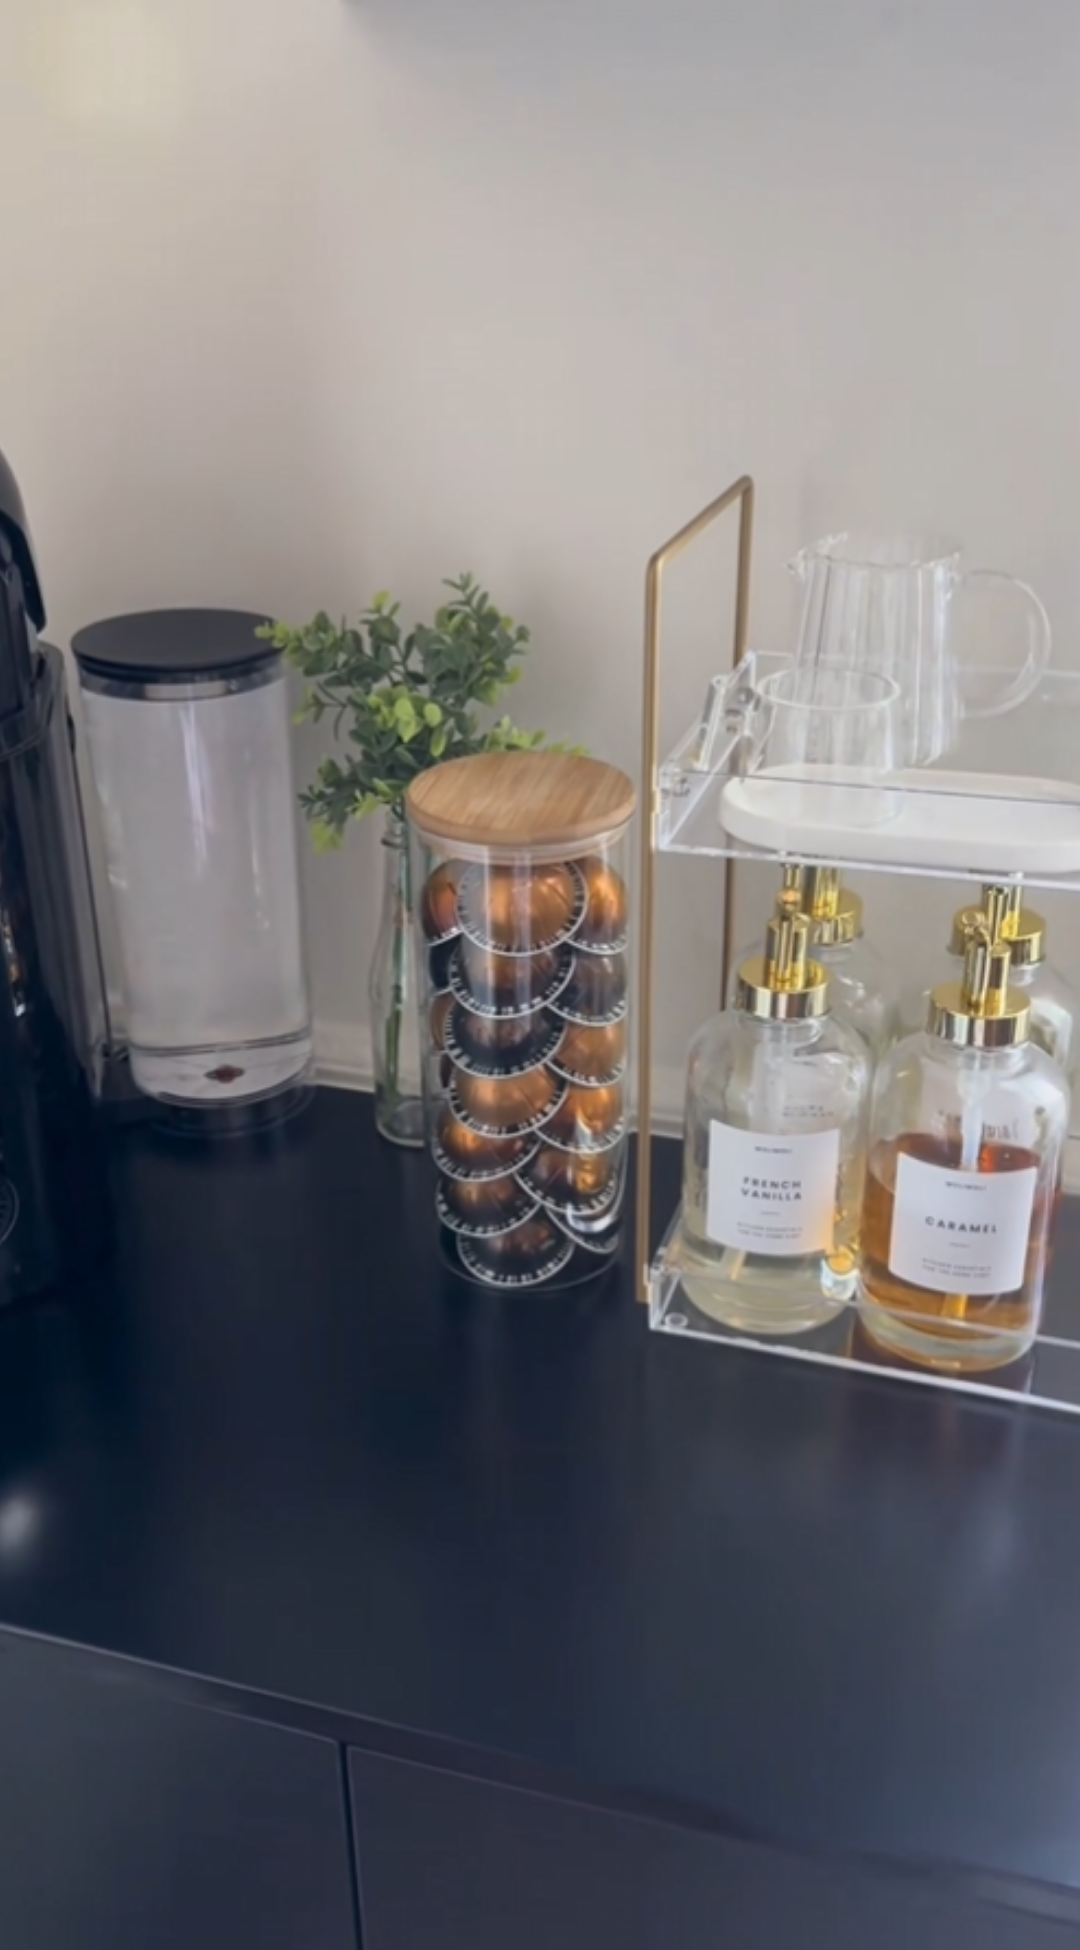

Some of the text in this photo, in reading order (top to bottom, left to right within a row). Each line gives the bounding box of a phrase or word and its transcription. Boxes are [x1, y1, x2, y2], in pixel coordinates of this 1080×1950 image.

[743, 1176, 802, 1190] FRENCH
[741, 1187, 802, 1201] VANILLA
[924, 1215, 997, 1234] CARAMEL
